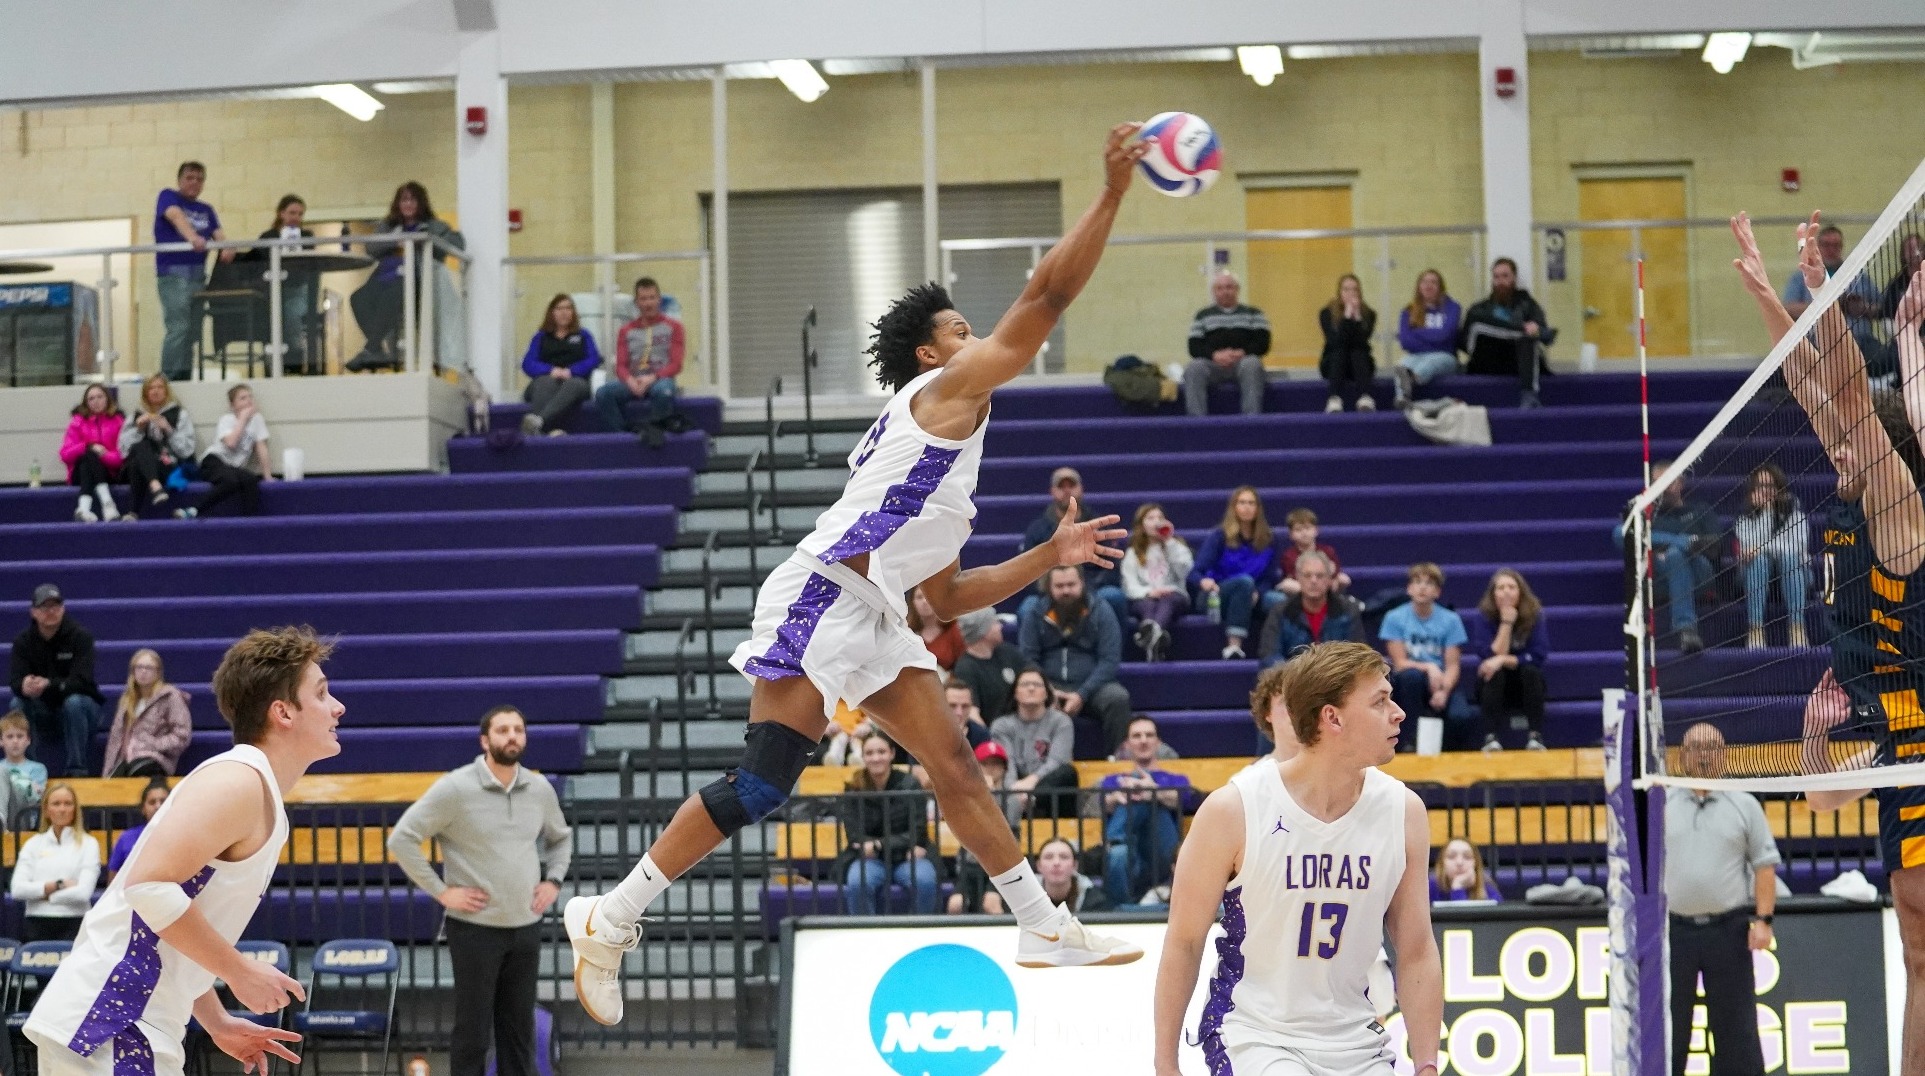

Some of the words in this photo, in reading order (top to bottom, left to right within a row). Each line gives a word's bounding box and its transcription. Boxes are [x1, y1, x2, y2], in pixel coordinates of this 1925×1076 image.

[1285, 853, 1371, 890] LORAS
[1297, 901, 1349, 960] 13
[21, 951, 71, 967] LOR
[880, 1010, 1014, 1053] NCAA
